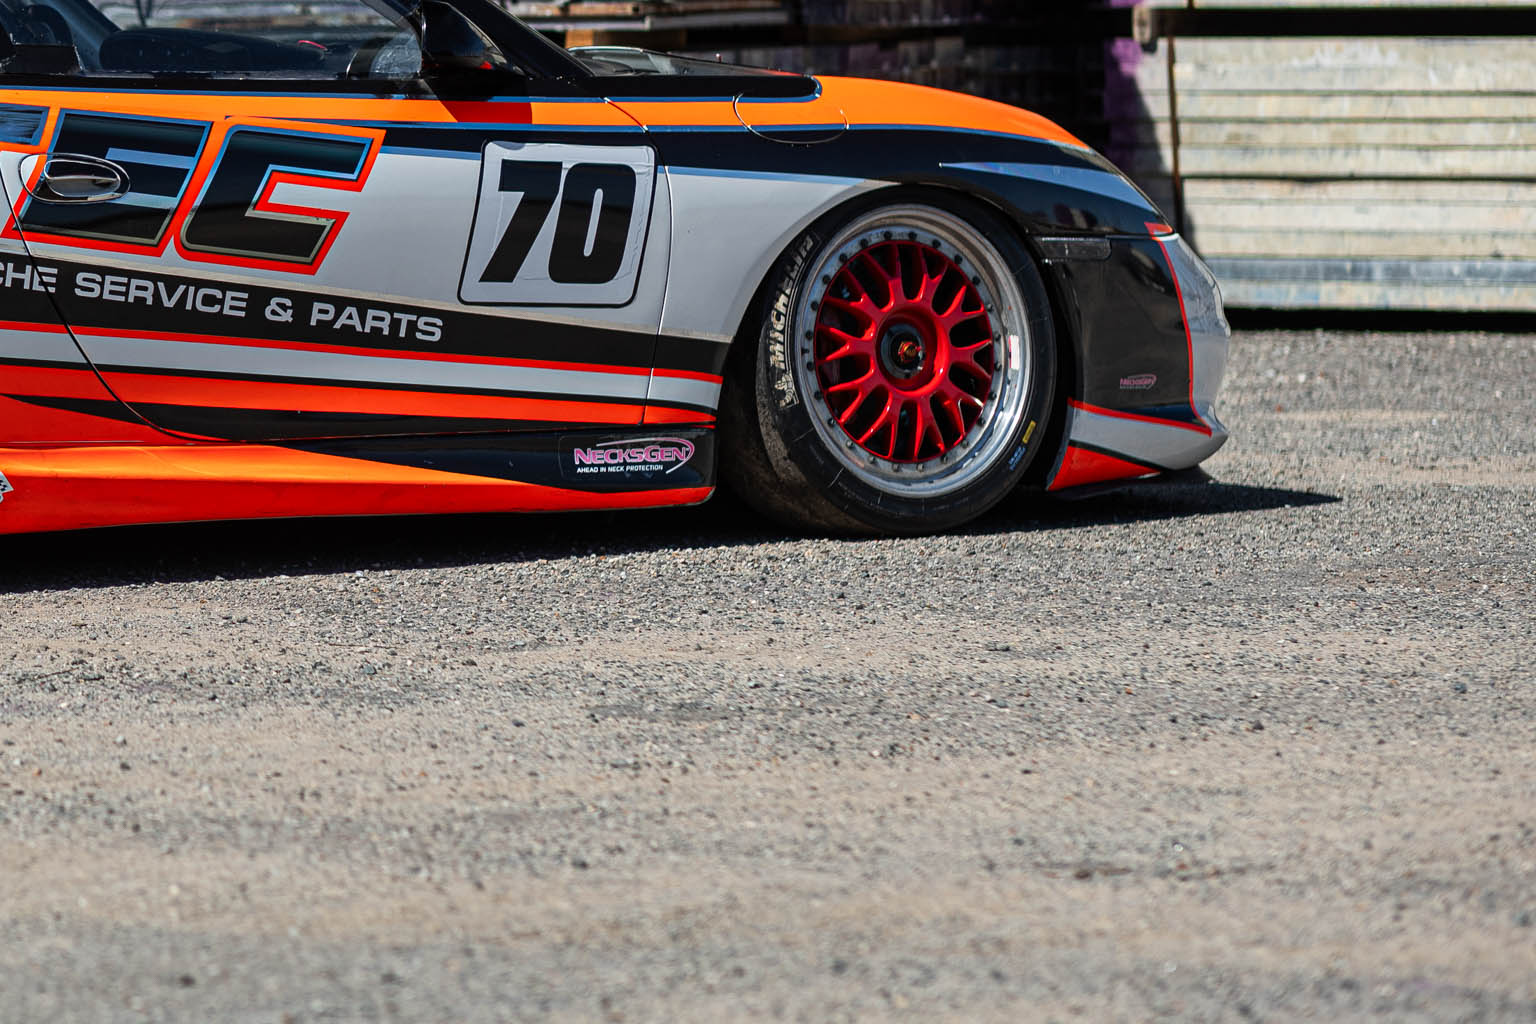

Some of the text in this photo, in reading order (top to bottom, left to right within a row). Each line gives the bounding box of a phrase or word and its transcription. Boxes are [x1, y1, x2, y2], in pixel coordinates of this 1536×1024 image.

[478, 158, 637, 285] 70
[74, 271, 249, 318] SERVICE
[265, 297, 294, 323] &
[310, 301, 444, 342] PARTS
[576, 466, 599, 474] AHEAD
[608, 465, 625, 473] NECK
[626, 464, 664, 472] PROTECTION
